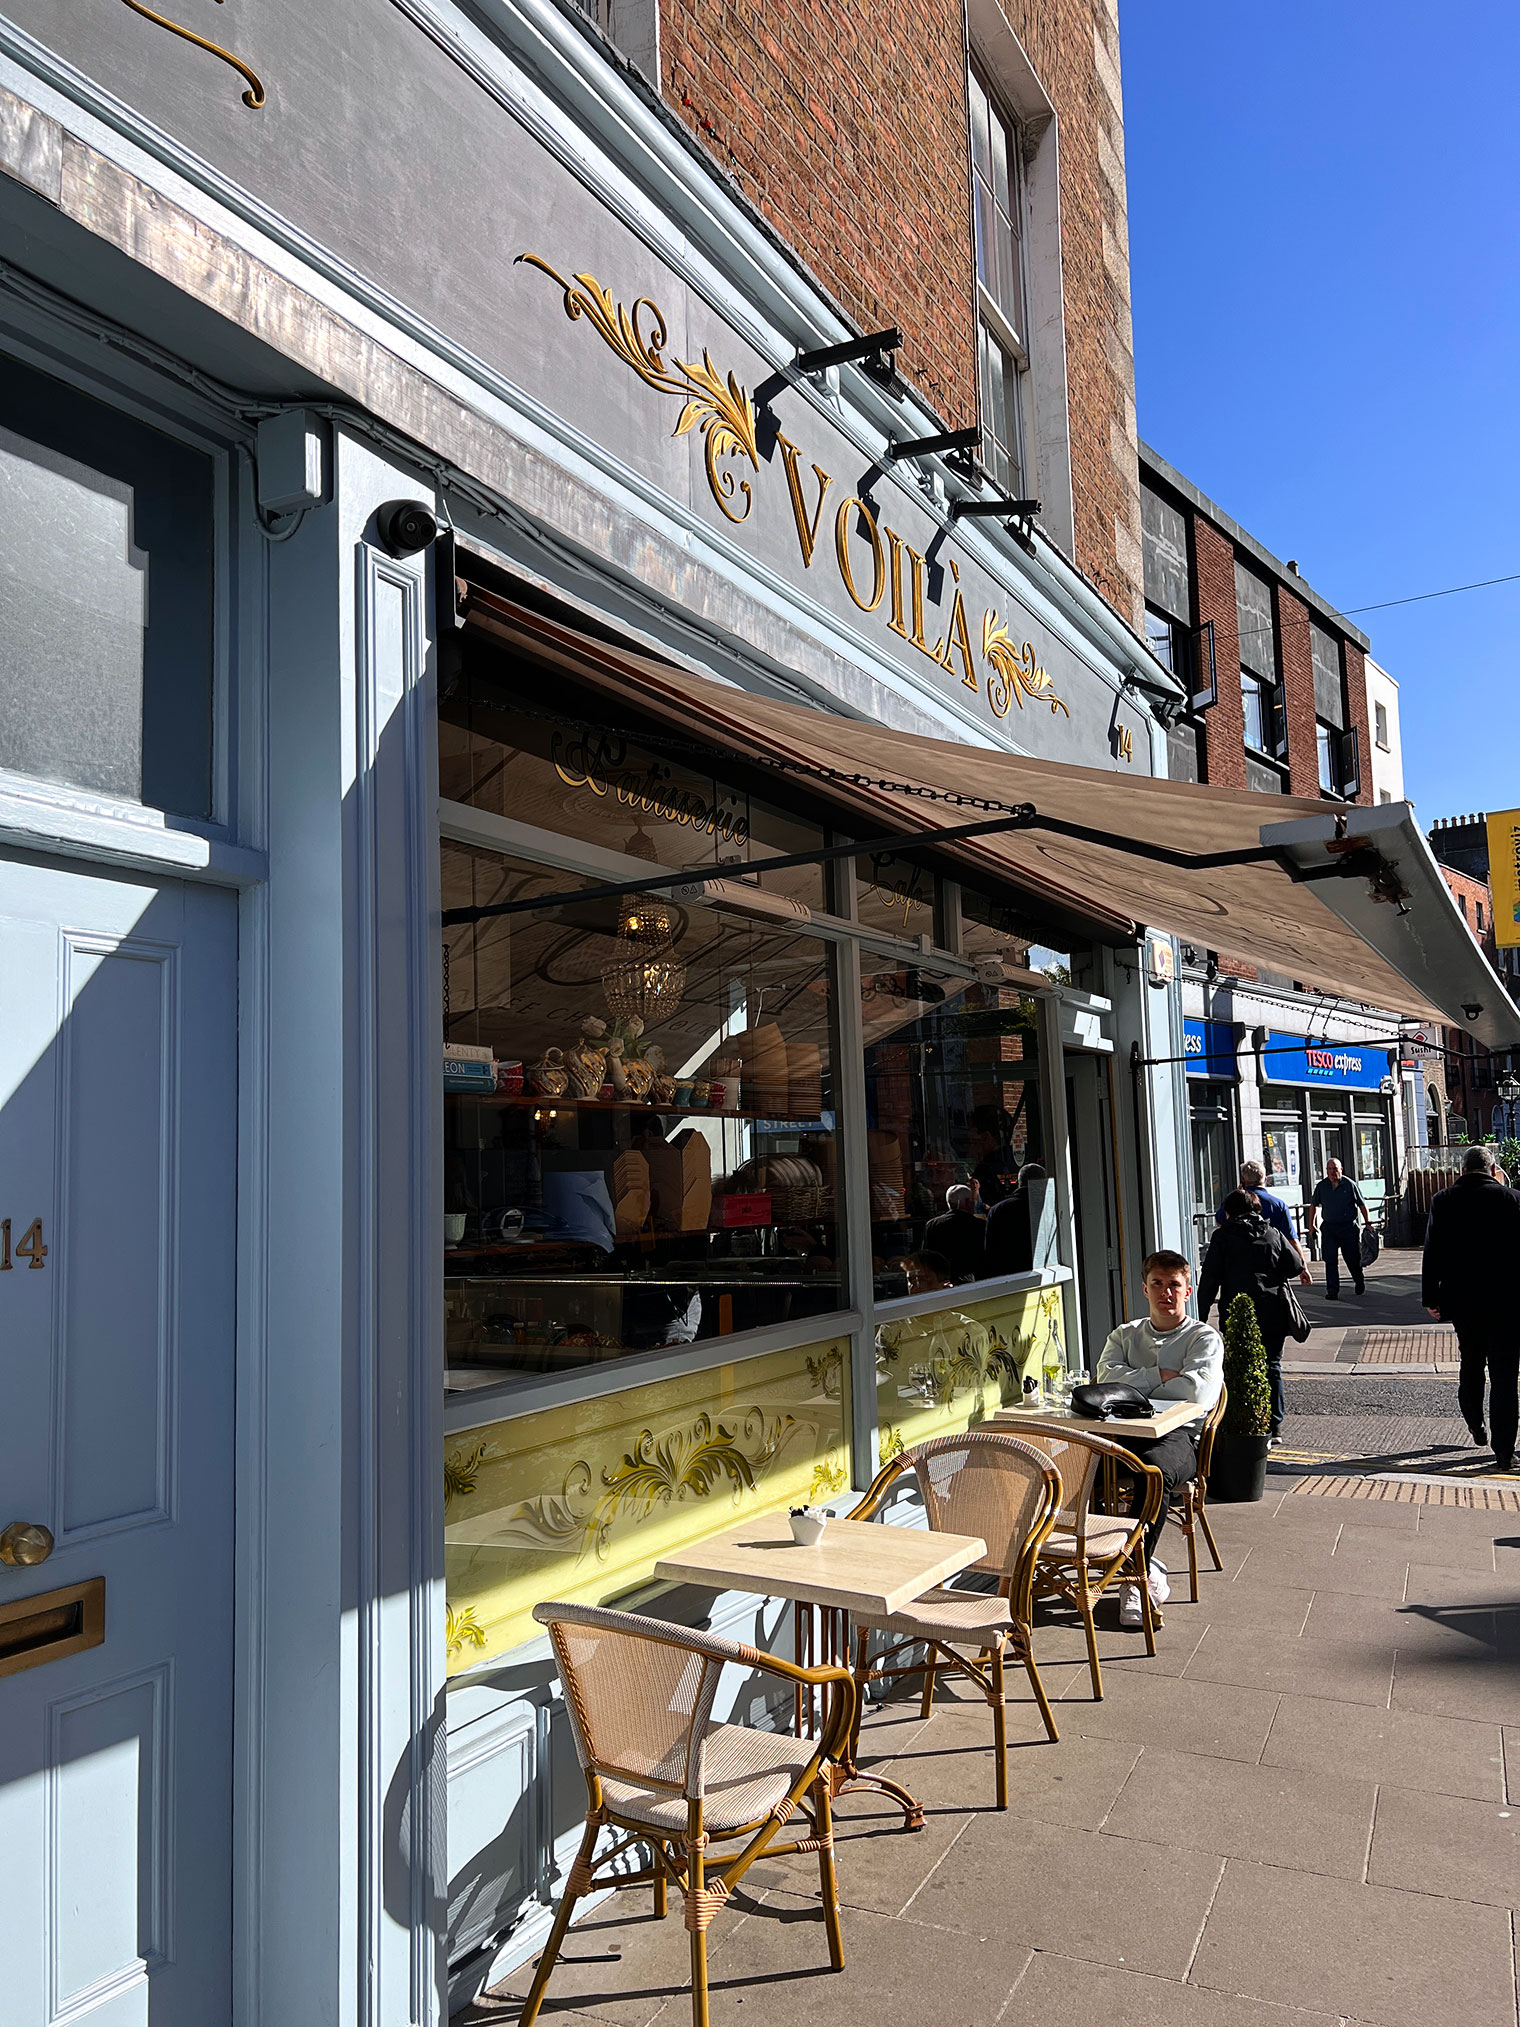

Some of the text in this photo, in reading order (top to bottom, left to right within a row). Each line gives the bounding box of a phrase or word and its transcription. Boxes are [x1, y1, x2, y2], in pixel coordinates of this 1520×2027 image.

[776, 431, 979, 693] VOILÀ
[1117, 723, 1132, 763] 14
[551, 729, 748, 845] Patisserie
[1184, 1033, 1202, 1053] ess
[1306, 1049, 1362, 1075] TESCO express
[443, 1061, 465, 1074] EON
[0, 1217, 48, 1270] 14
